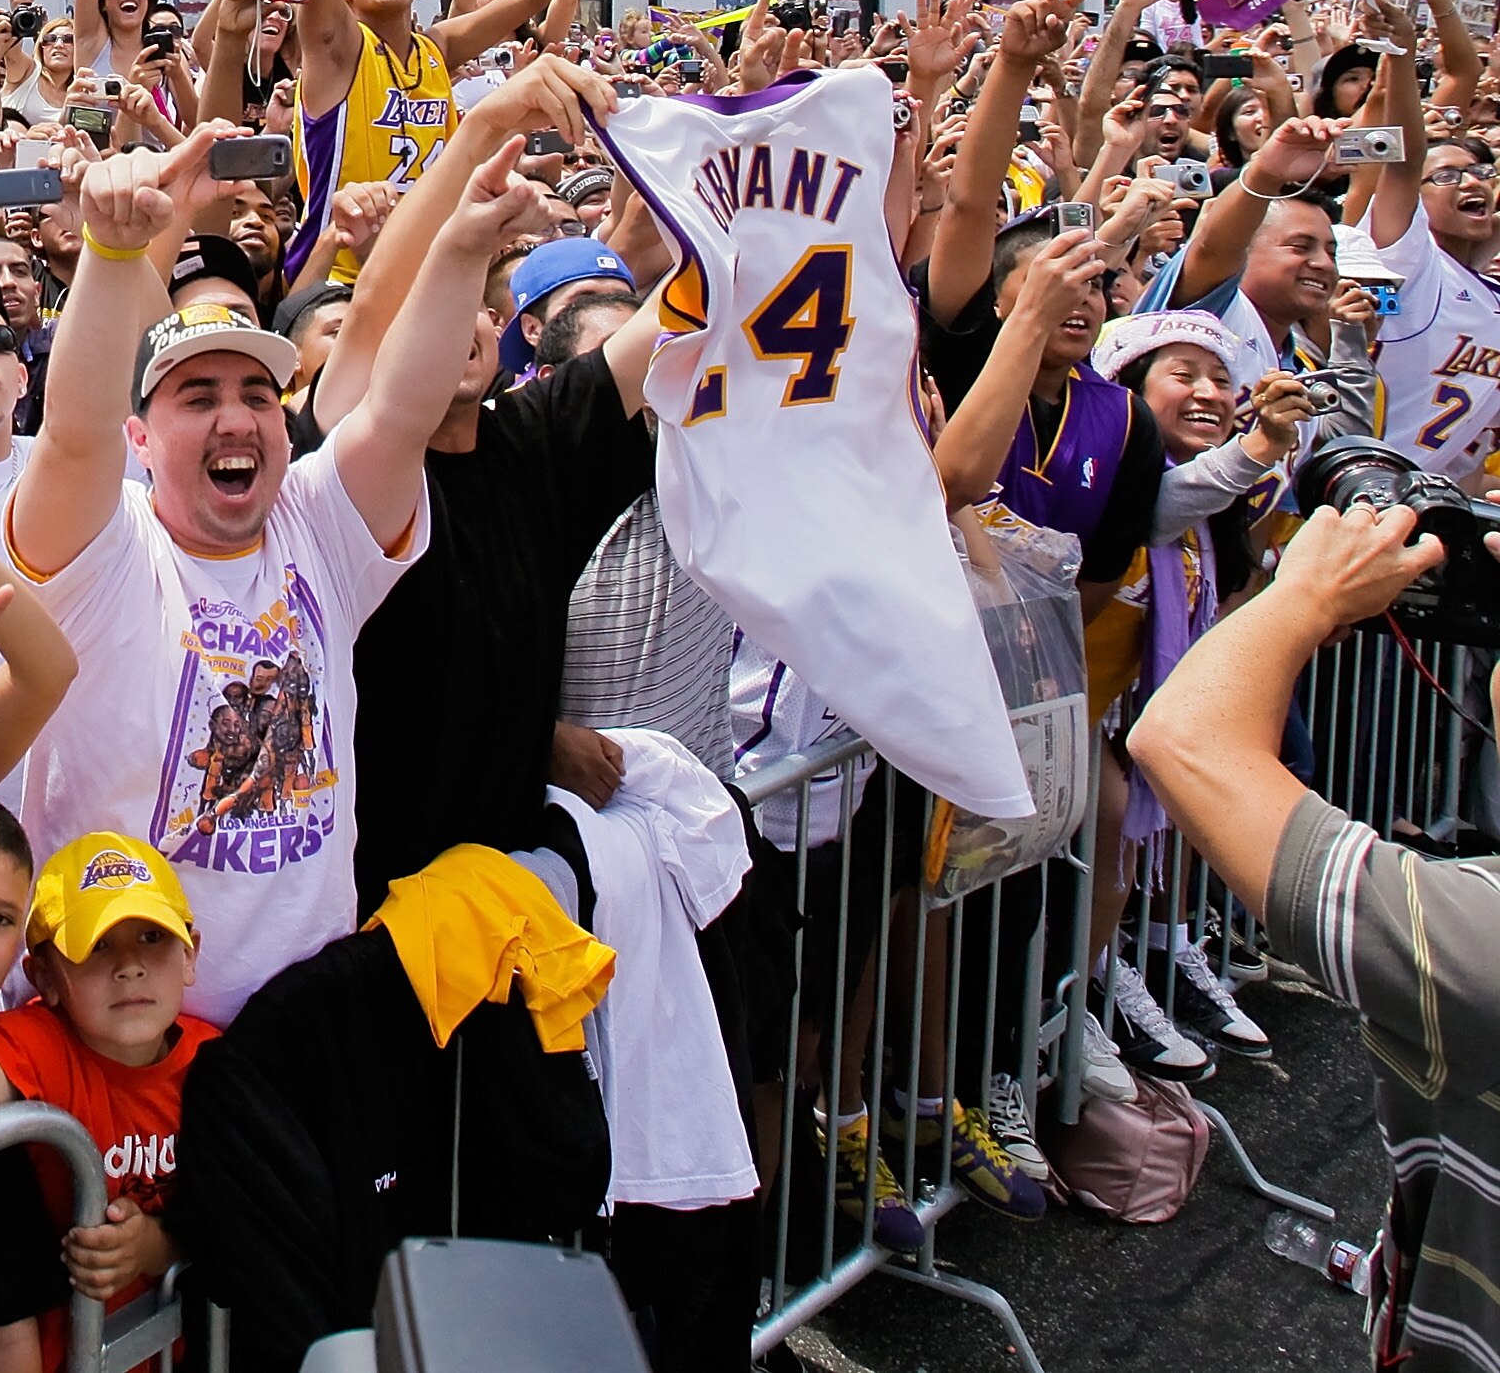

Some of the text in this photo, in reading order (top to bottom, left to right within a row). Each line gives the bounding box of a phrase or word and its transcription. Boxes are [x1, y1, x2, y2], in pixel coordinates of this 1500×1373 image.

[1164, 27, 1193, 47] 24
[371, 88, 448, 129] LAKER
[148, 313, 180, 345] 2010
[1151, 317, 1224, 348] LAKERS
[220, 814, 298, 831] LOS ANGELES
[80, 864, 152, 890] LAKERS
